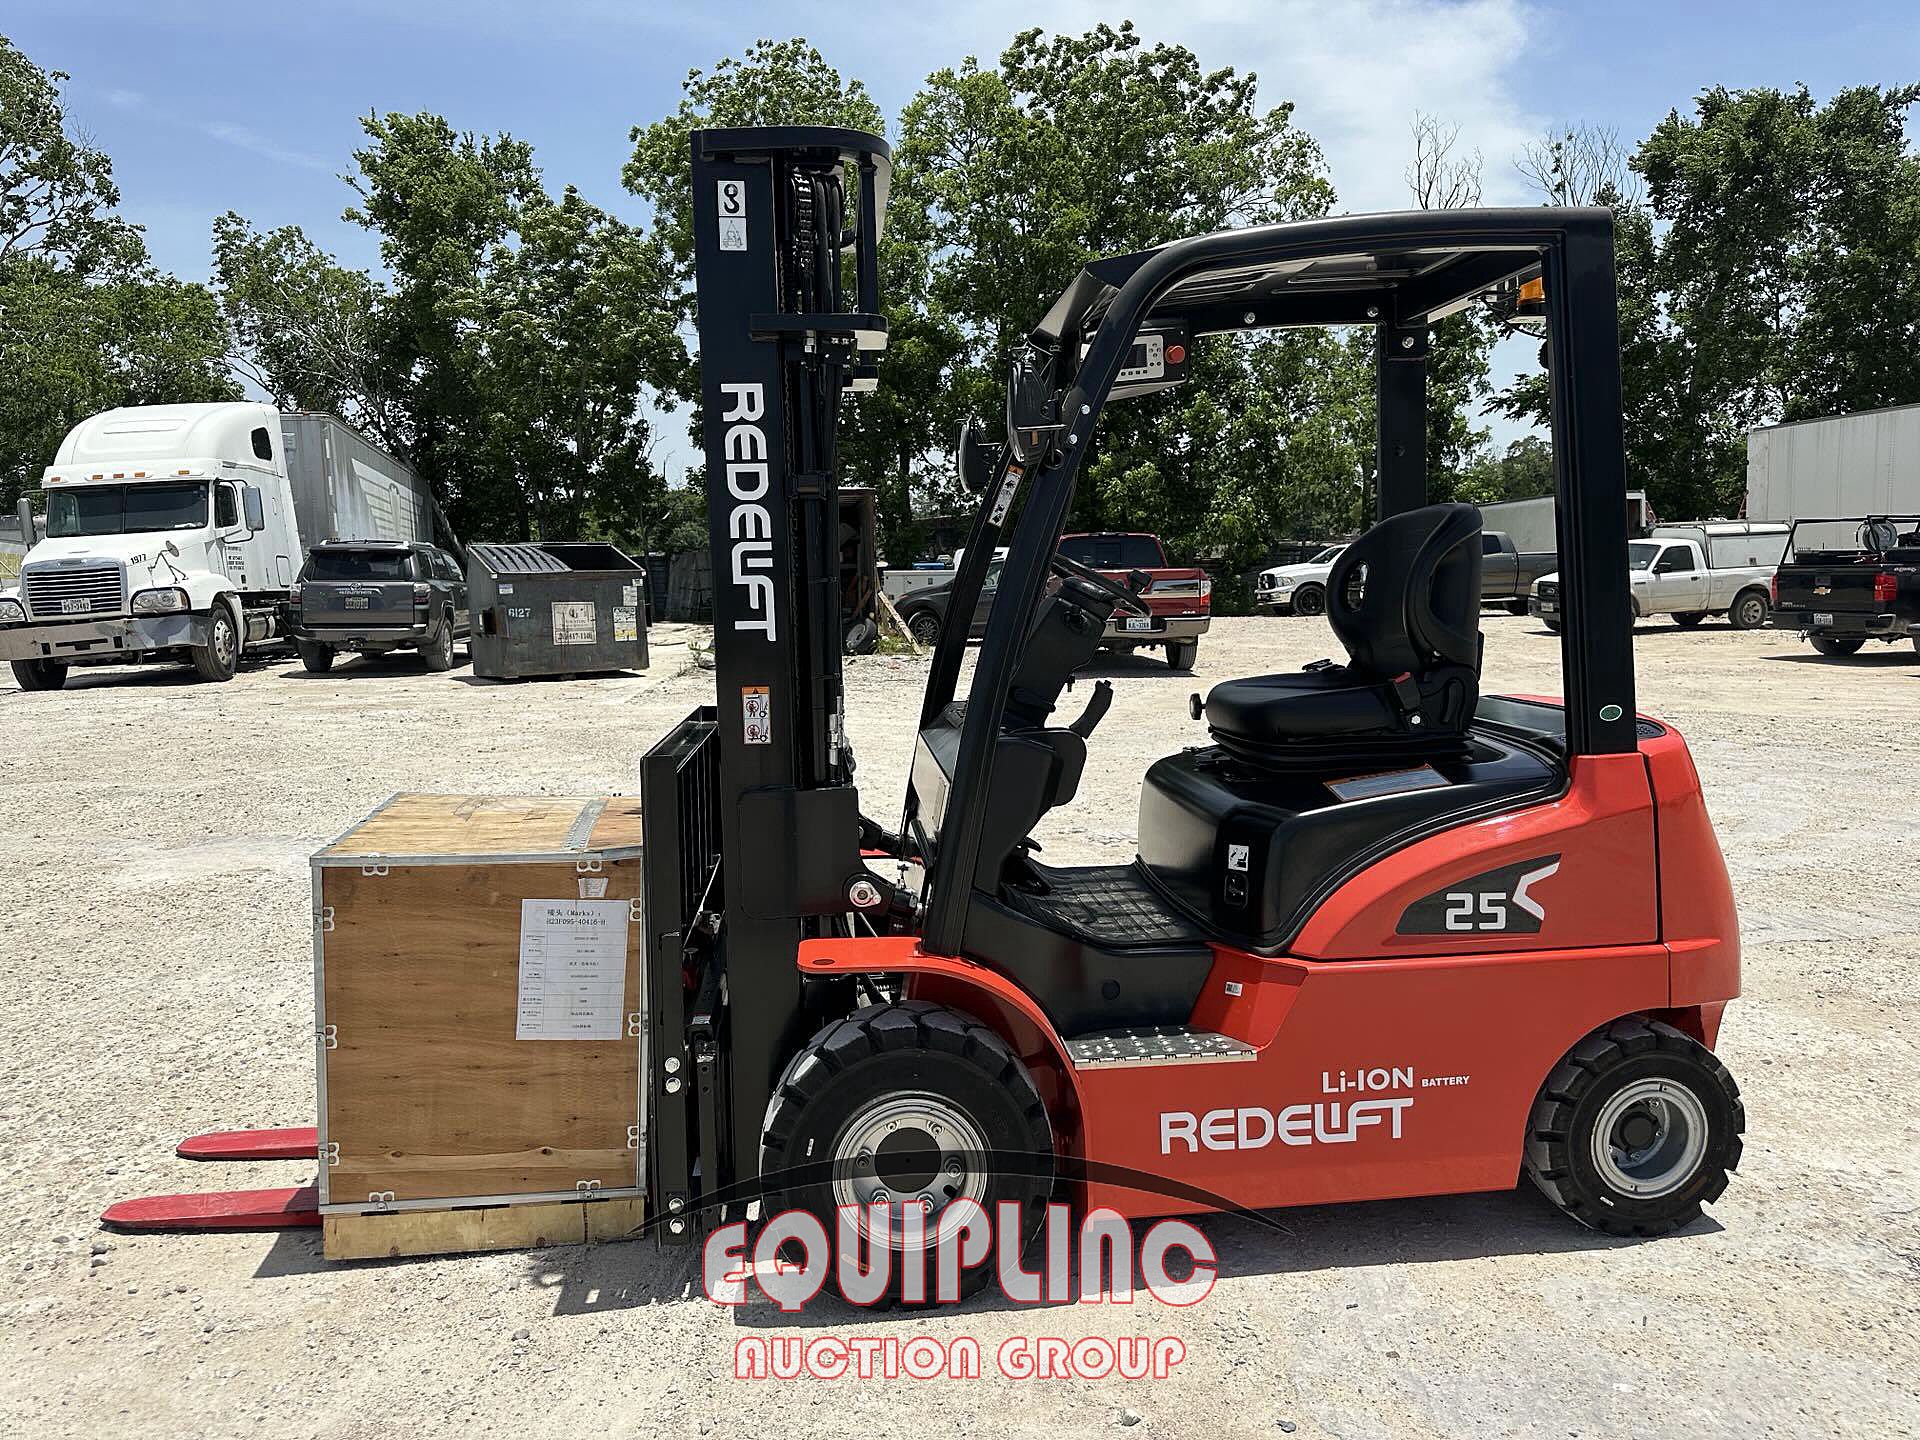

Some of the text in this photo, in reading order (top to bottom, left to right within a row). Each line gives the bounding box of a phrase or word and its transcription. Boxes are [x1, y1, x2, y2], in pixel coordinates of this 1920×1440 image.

[720, 382, 777, 642] REDELIFT
[130, 553, 147, 566] 1977
[508, 607, 531, 618] 6127
[1445, 891, 1507, 931] 25
[1322, 1066, 1470, 1094] Li-ION BATTERY
[1160, 1097, 1414, 1155] REDELIFT
